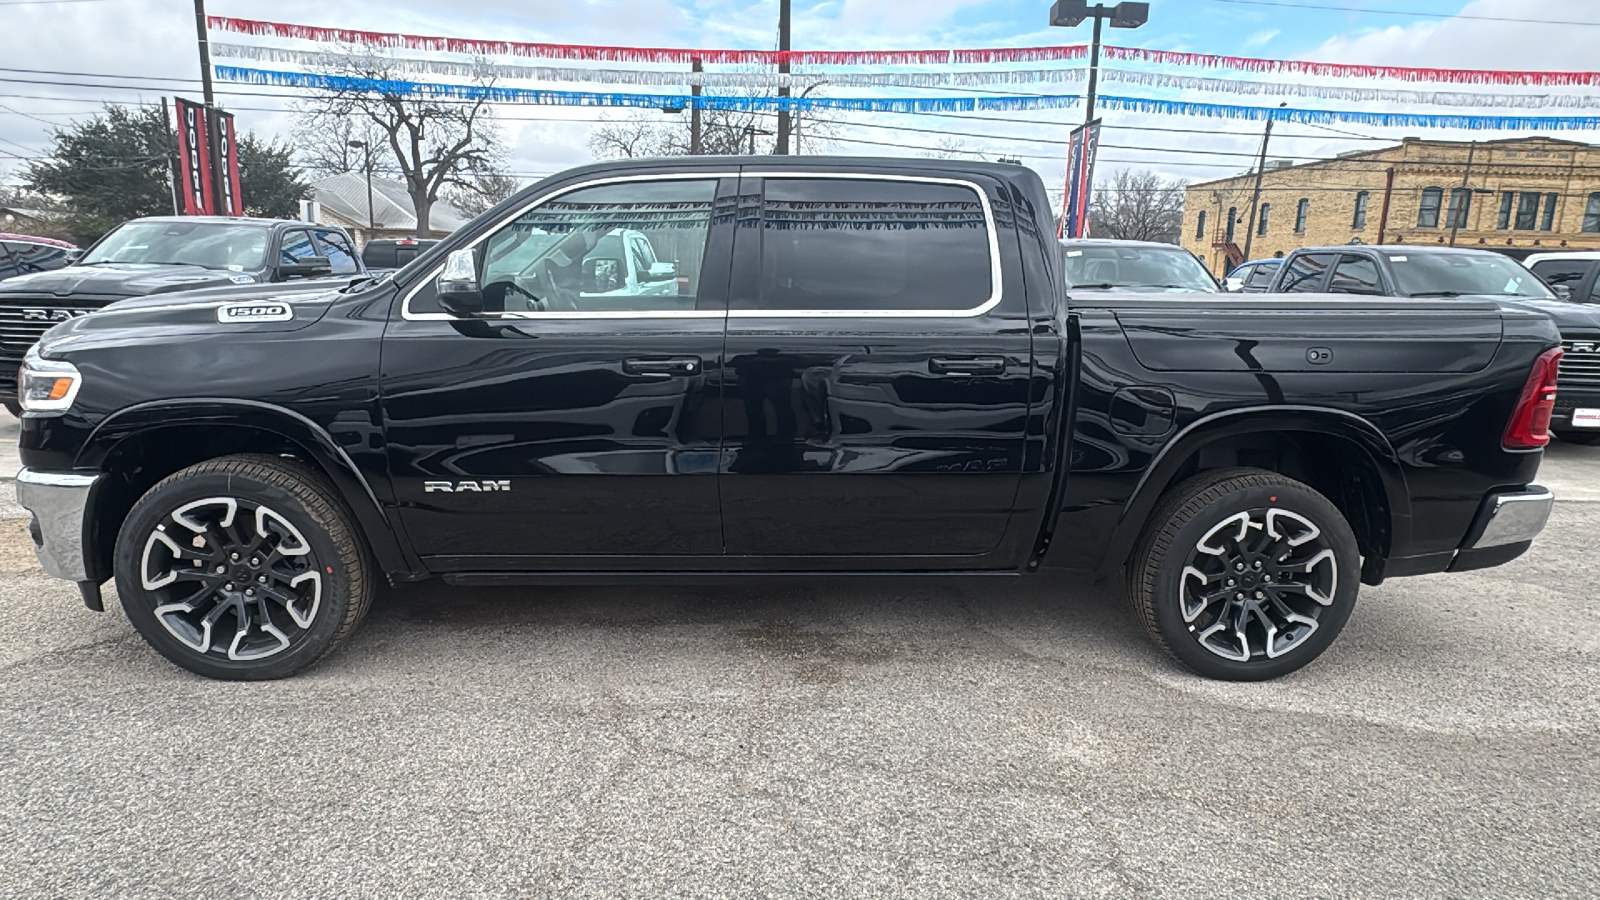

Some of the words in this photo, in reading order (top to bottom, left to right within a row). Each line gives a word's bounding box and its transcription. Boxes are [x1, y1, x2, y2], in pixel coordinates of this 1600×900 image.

[23, 309, 95, 320] RA
[228, 306, 283, 316] 1500
[424, 480, 511, 492] RAM
